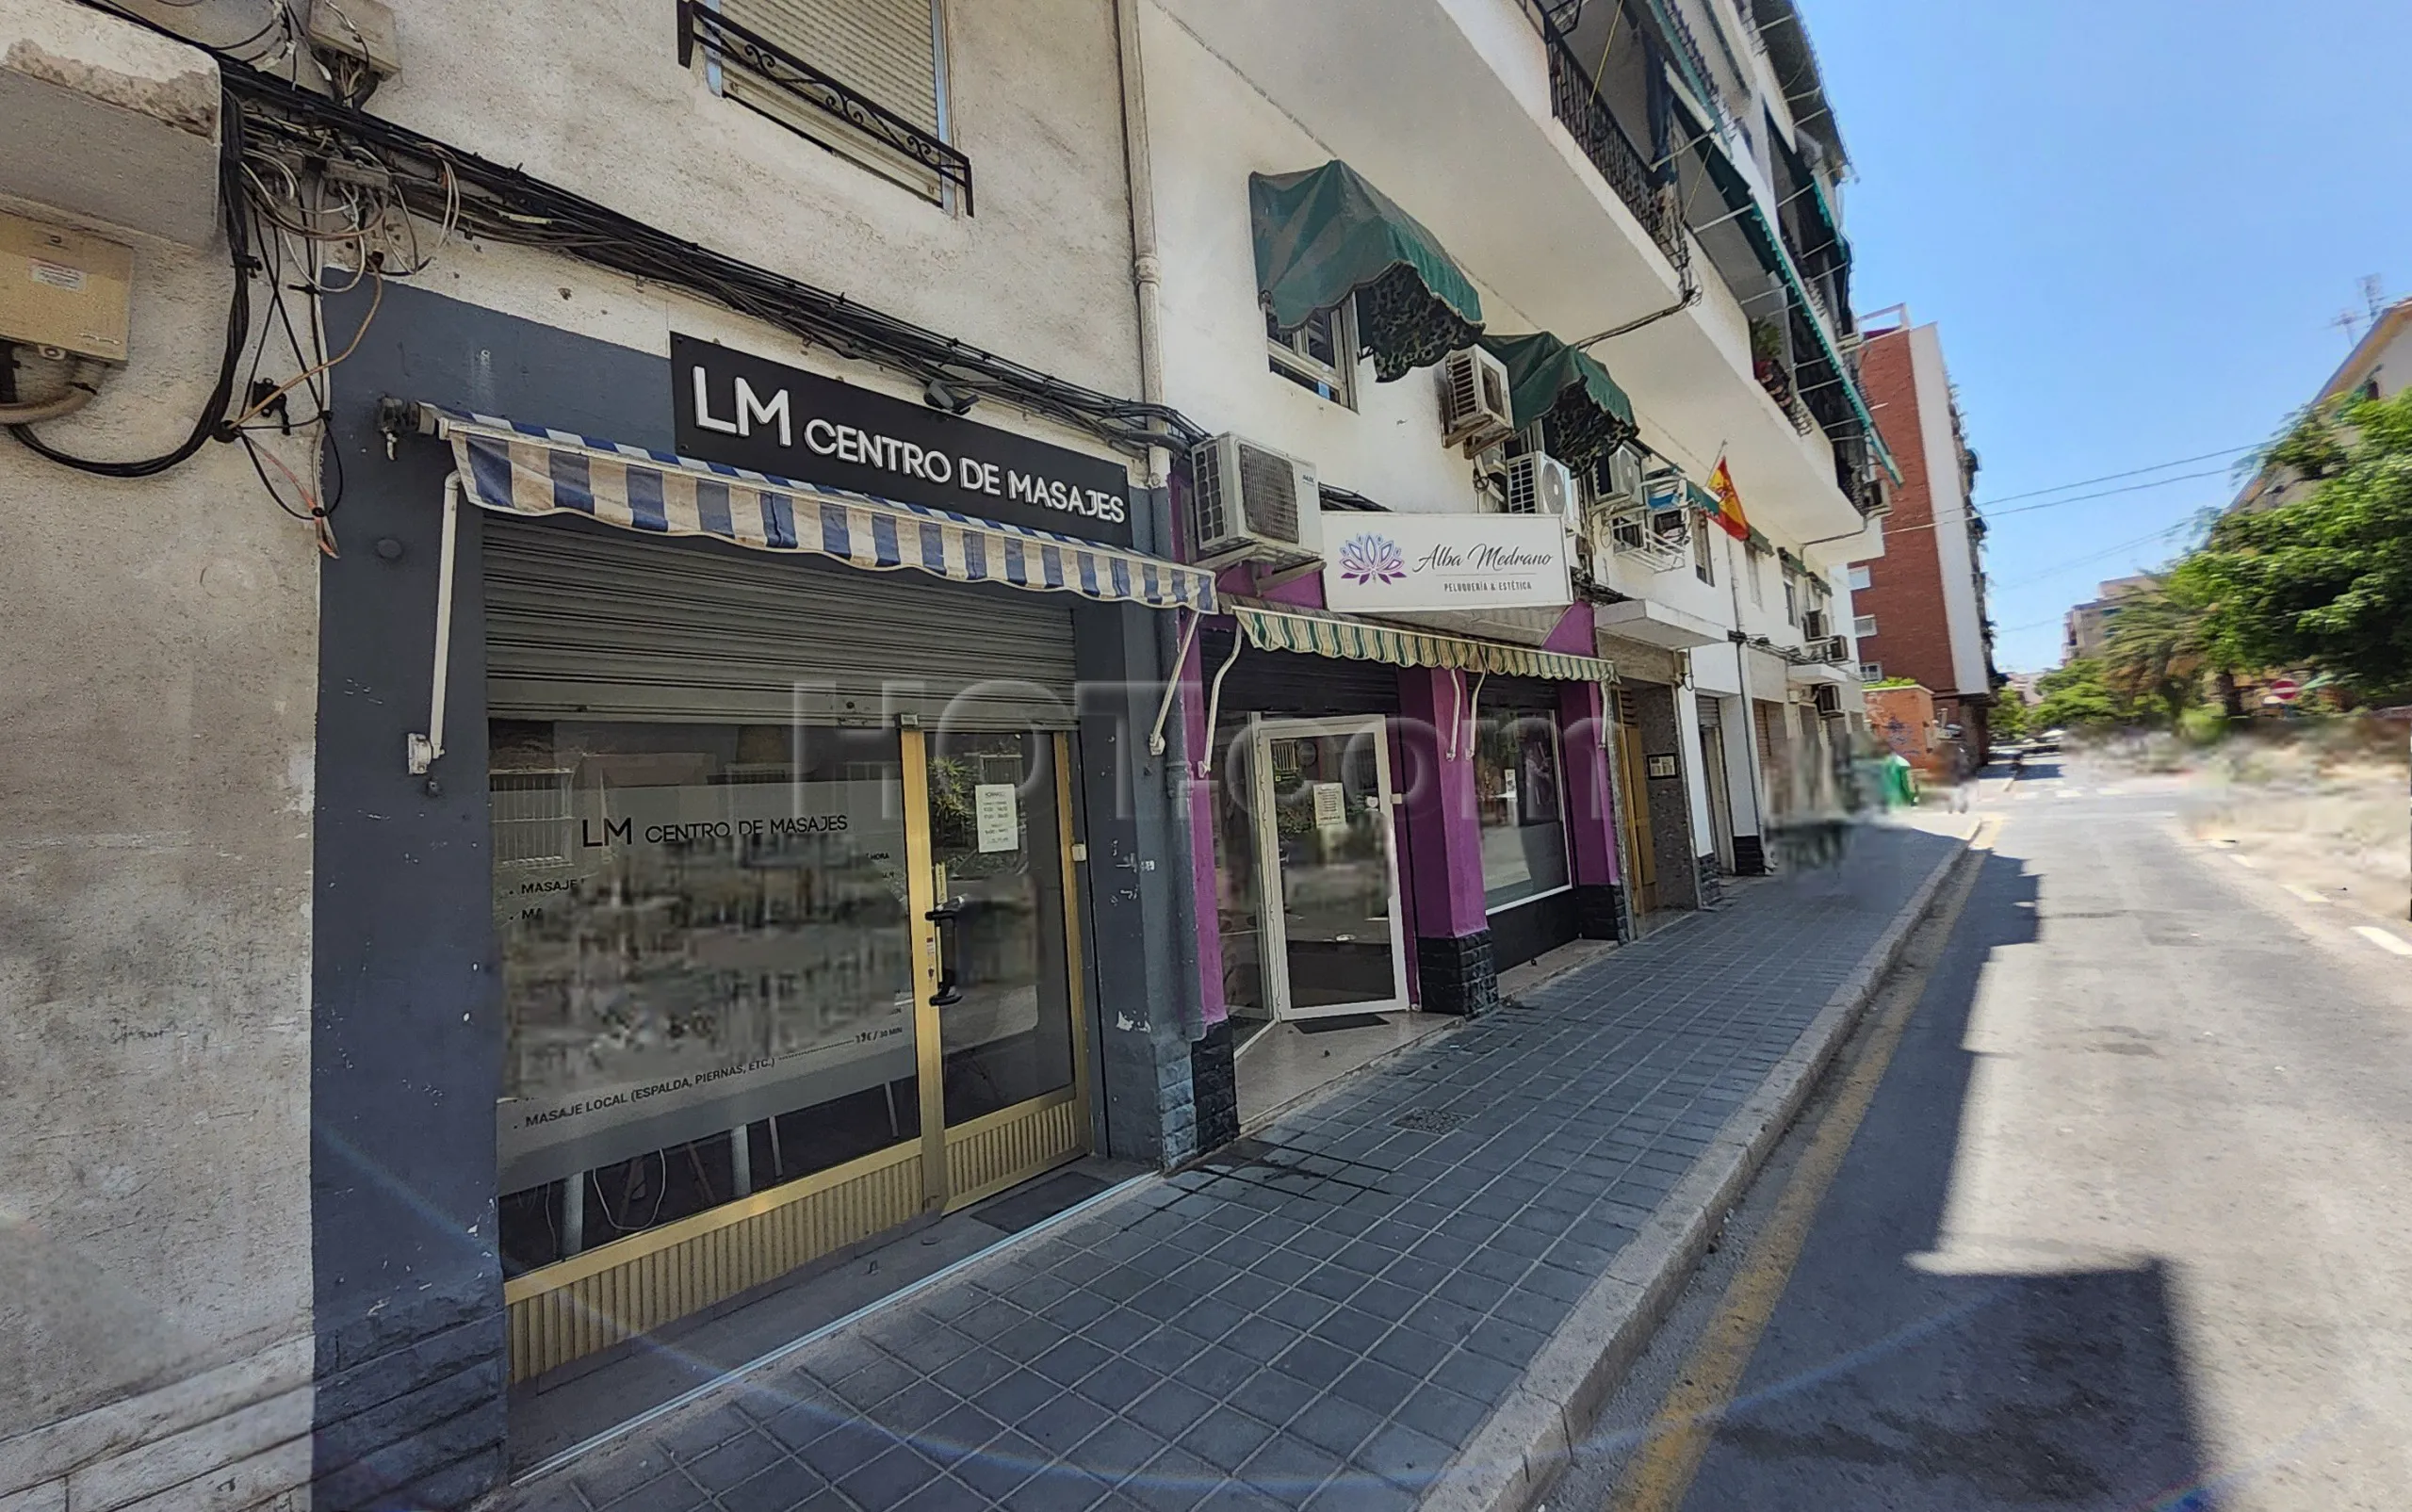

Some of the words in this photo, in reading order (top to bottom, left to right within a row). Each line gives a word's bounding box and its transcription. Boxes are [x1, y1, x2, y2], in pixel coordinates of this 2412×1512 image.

[693, 366, 791, 447] LM
[804, 418, 952, 484] CENTRO
[959, 456, 1001, 493] DE
[1008, 470, 1126, 525] MASAJES
[1411, 543, 1462, 573] Alba
[1467, 543, 1554, 572] Medrano
[1443, 580, 1488, 593] PELUQUERÍA
[1498, 579, 1532, 592] ESTÉTICA
[581, 817, 633, 848] LM
[644, 821, 730, 843] CENTRO
[738, 820, 763, 836] DE
[770, 815, 848, 835] MASAJES
[524, 1104, 583, 1129] MASAJE
[585, 1092, 628, 1113] LOCAL
[694, 1065, 746, 1085] PIERNAS,
[748, 1057, 775, 1071] ETC.)
